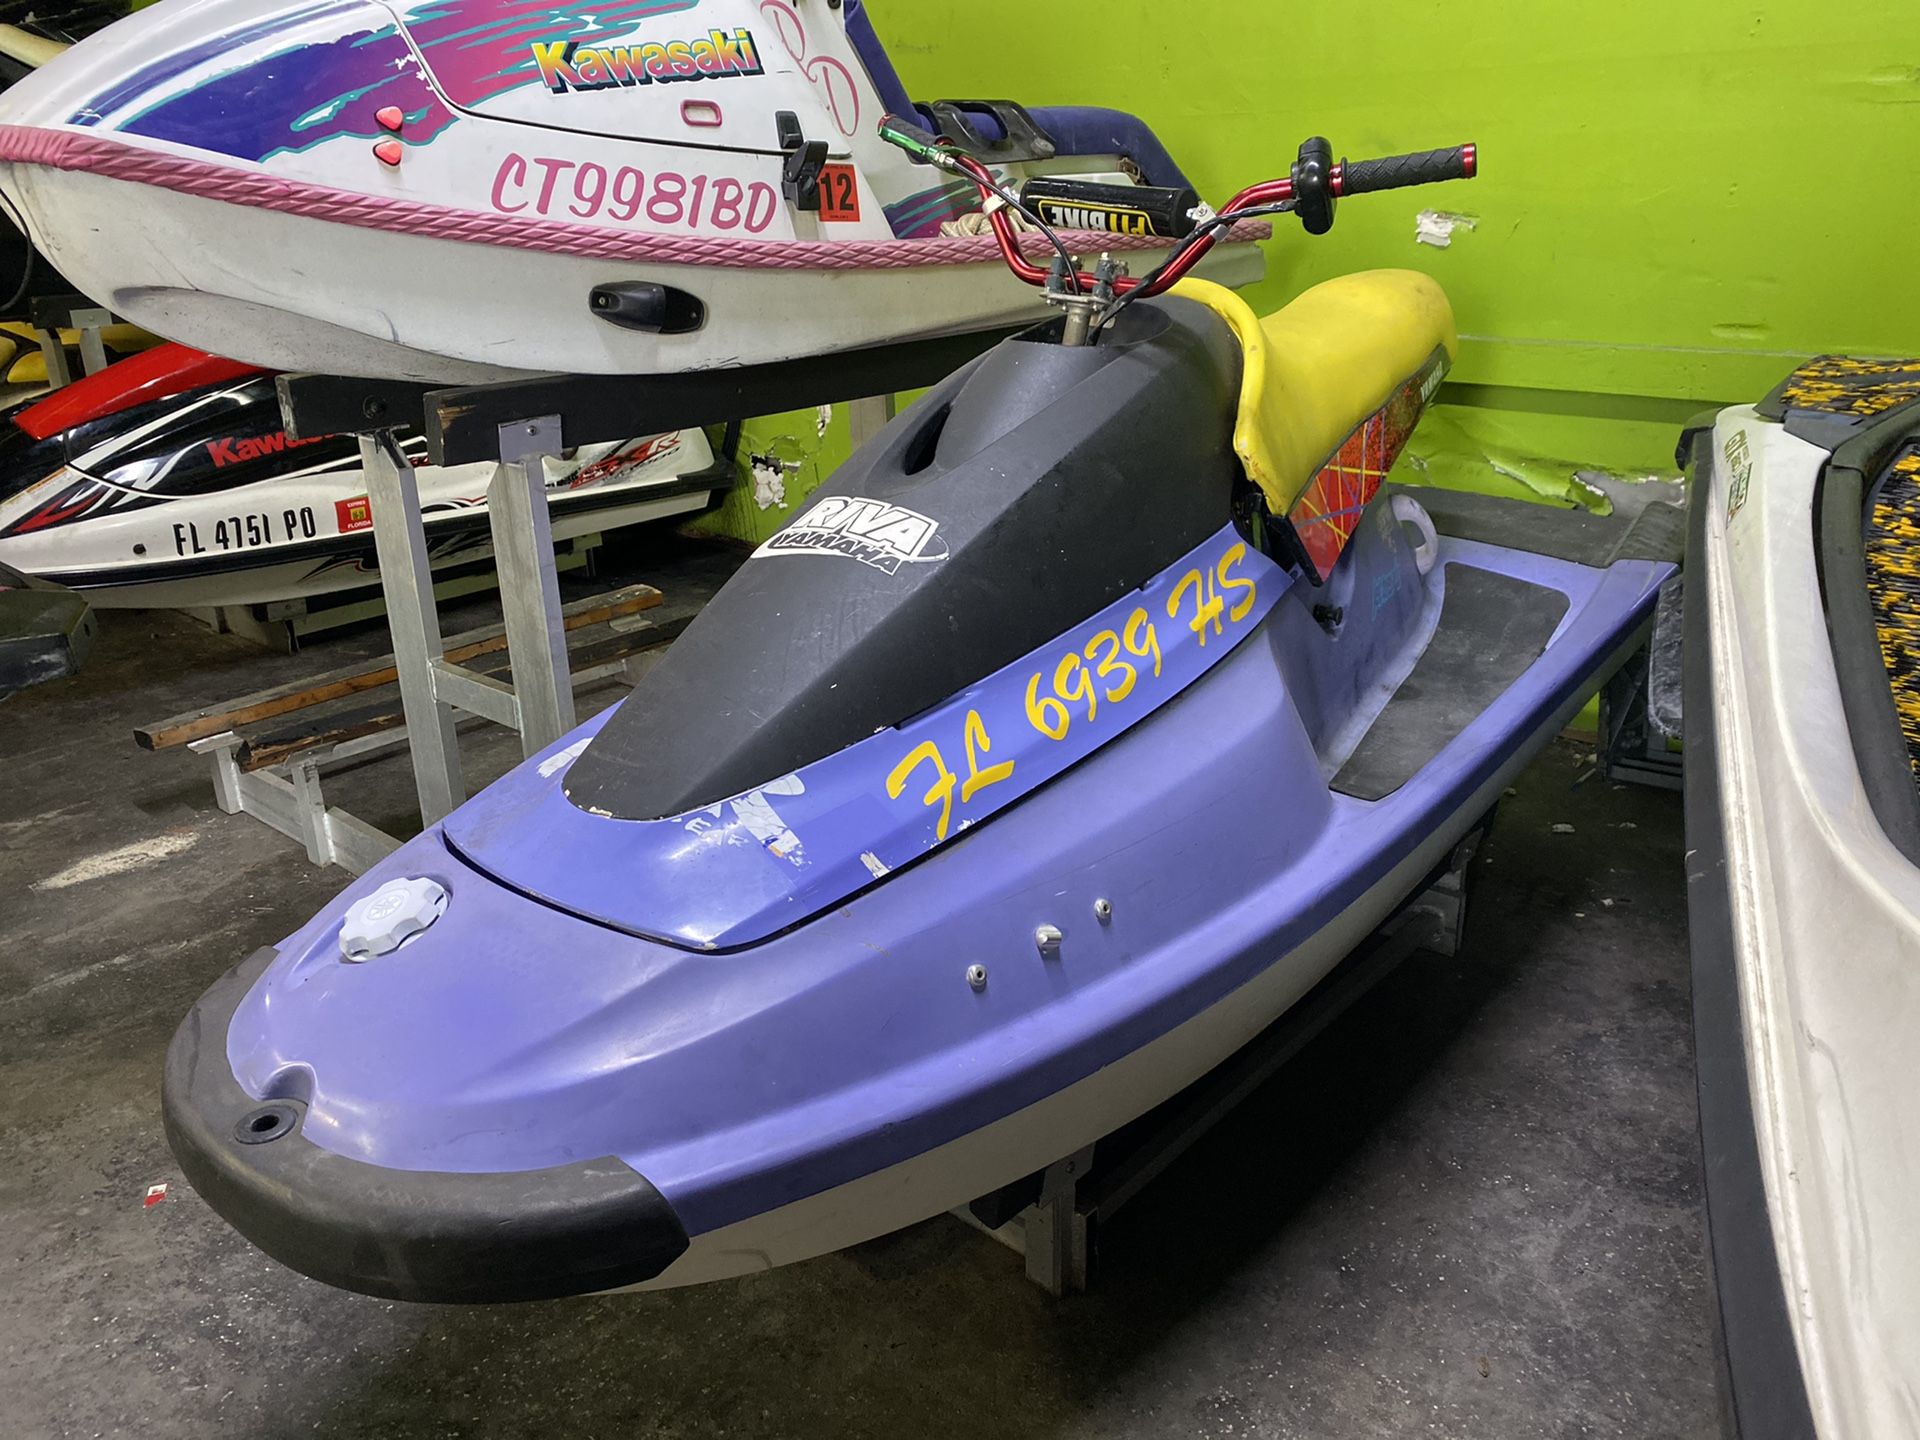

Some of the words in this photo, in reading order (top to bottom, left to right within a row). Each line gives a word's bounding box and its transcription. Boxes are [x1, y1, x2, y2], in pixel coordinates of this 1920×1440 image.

[531, 28, 764, 94] Kawasaki
[491, 152, 777, 234] CT9981BD
[820, 172, 854, 211] 12
[173, 522, 206, 556] FL
[215, 513, 271, 550] 4751
[767, 530, 903, 576] YAMAHA
[788, 496, 939, 557] RIVA
[1025, 607, 1162, 741] 6939
